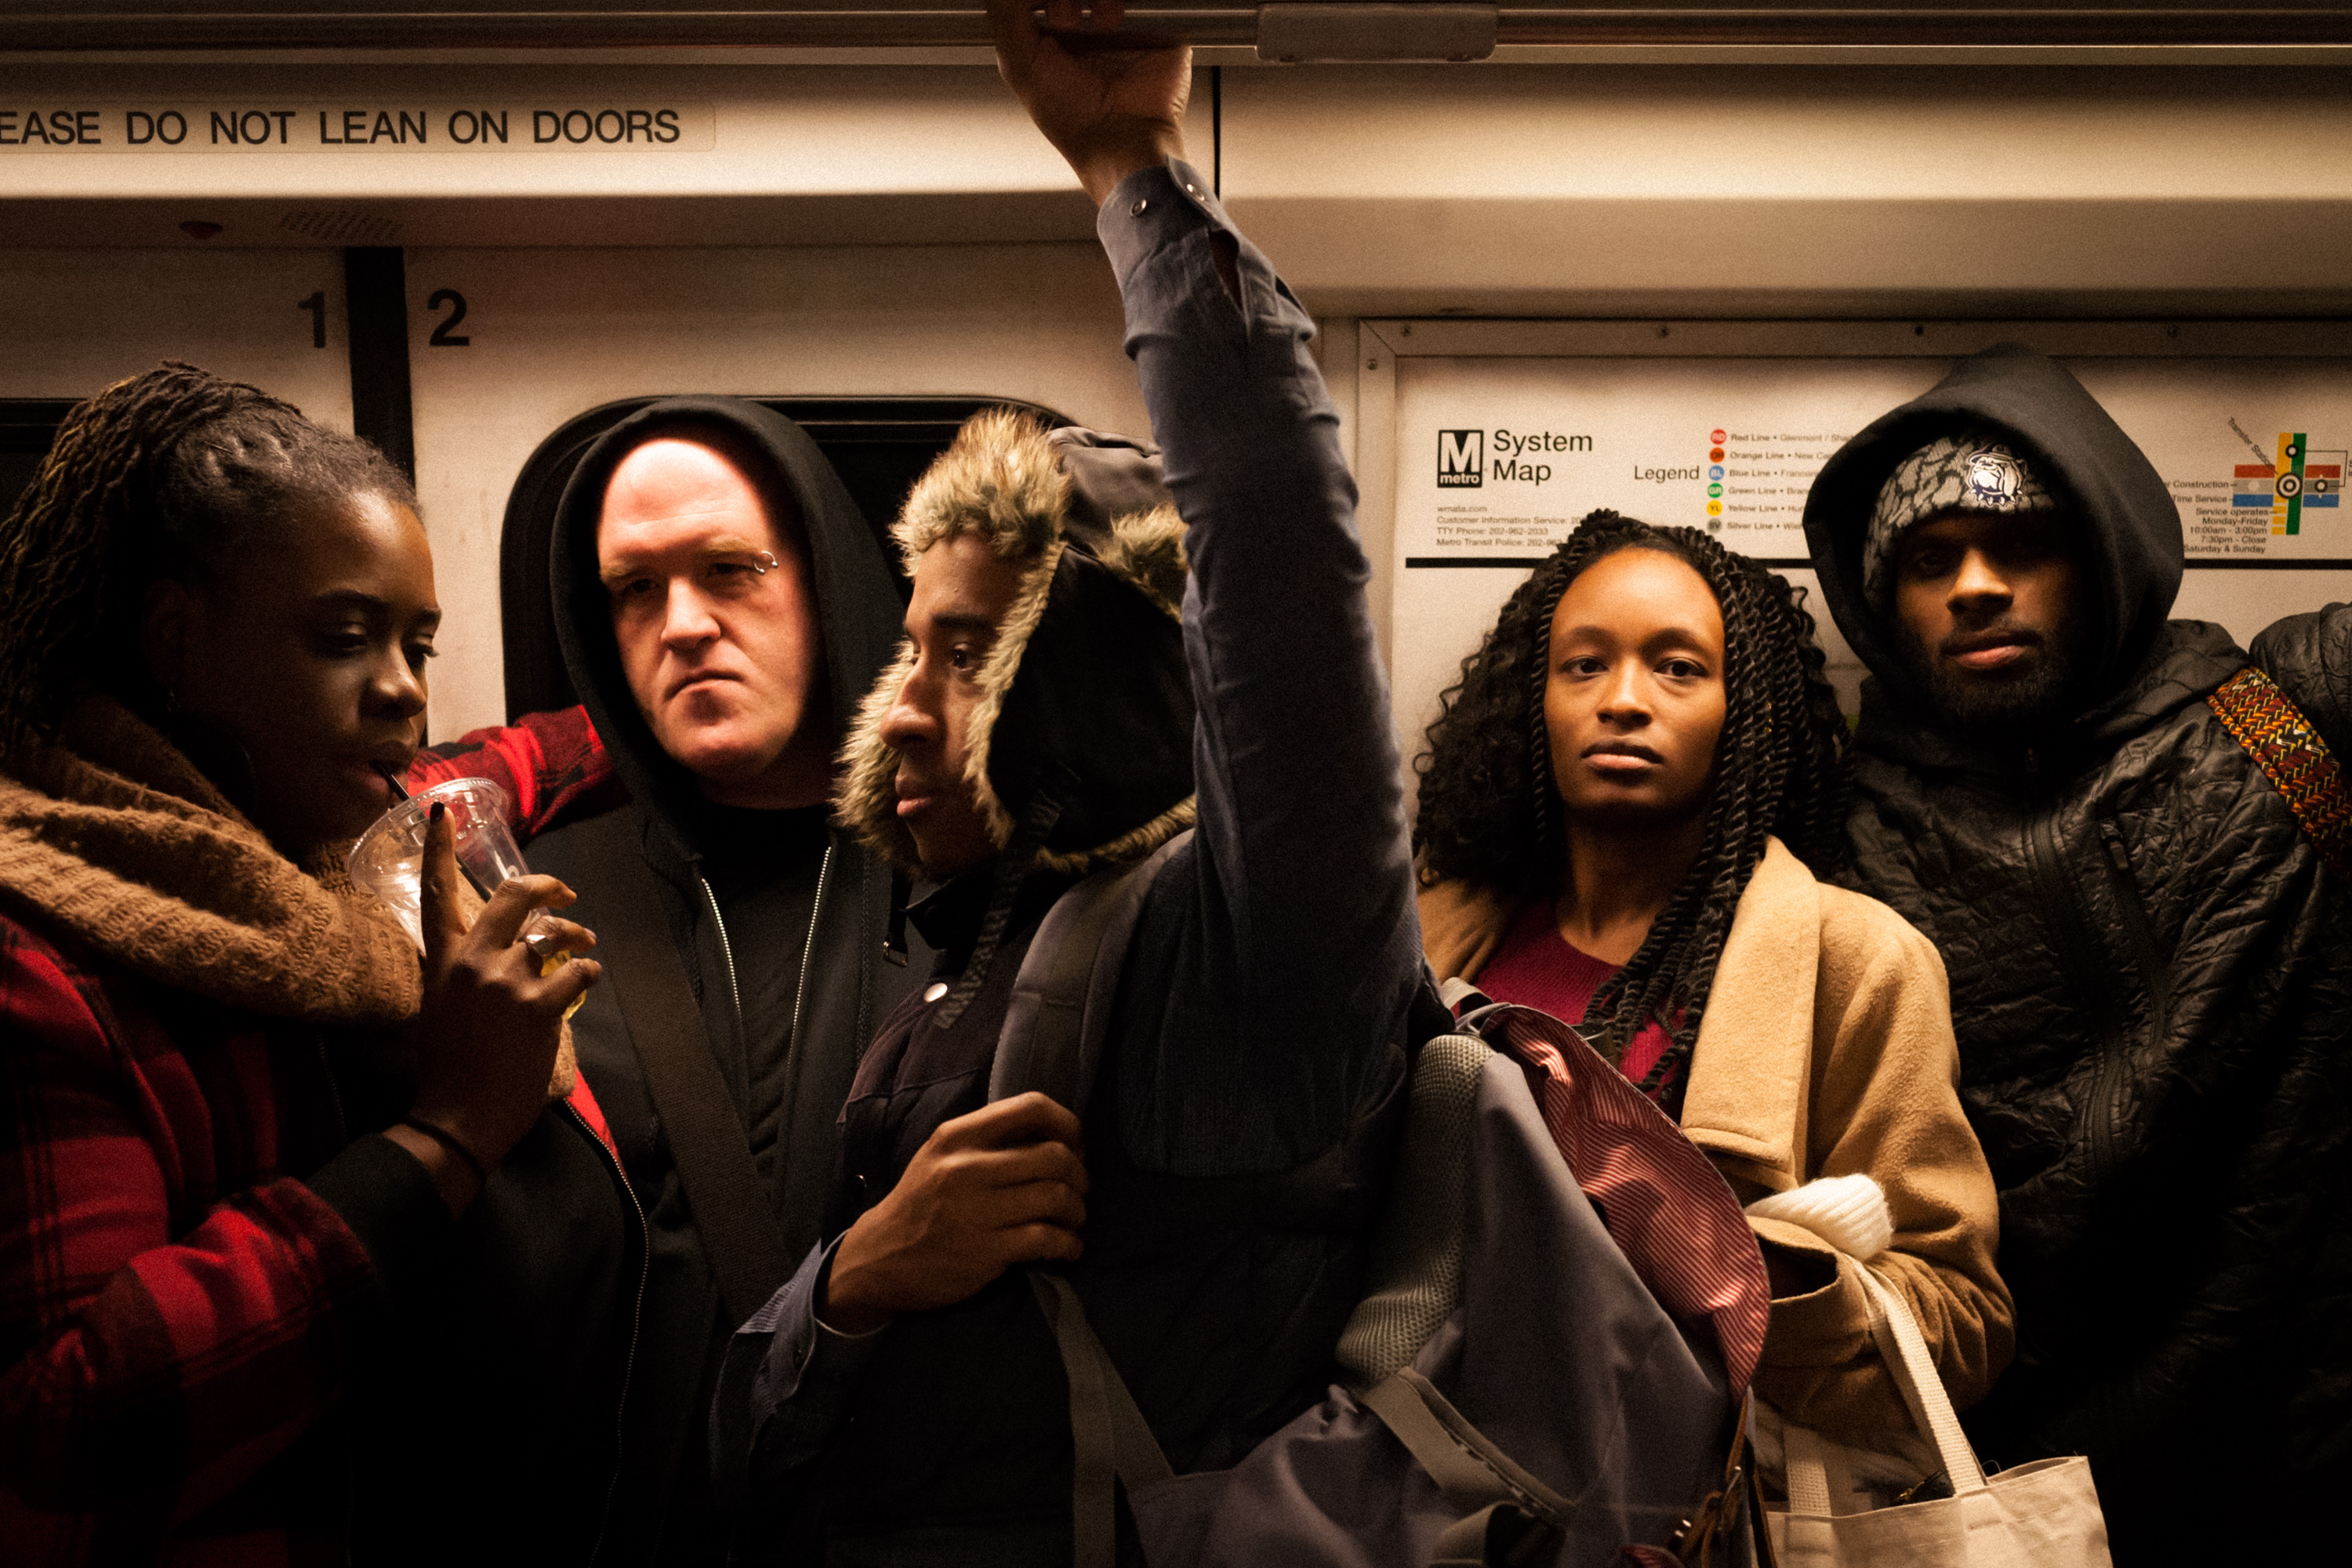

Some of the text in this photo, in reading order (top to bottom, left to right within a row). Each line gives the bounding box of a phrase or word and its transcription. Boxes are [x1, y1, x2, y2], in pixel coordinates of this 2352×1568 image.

[127, 111, 187, 144] DO
[211, 111, 296, 144] NOT
[320, 111, 426, 144] LEAN
[448, 110, 508, 143] ON
[533, 109, 680, 143] DOORS
[298, 292, 326, 348] 1
[427, 289, 470, 347] 2
[1494, 430, 1592, 456] System
[1730, 452, 1762, 461] Orange
[1440, 472, 1479, 485] metro
[1494, 459, 1552, 485] Map
[1634, 465, 1700, 483] Legend
[2202, 517, 2268, 526] Monday-Friday
[2233, 545, 2266, 554] Sunday
